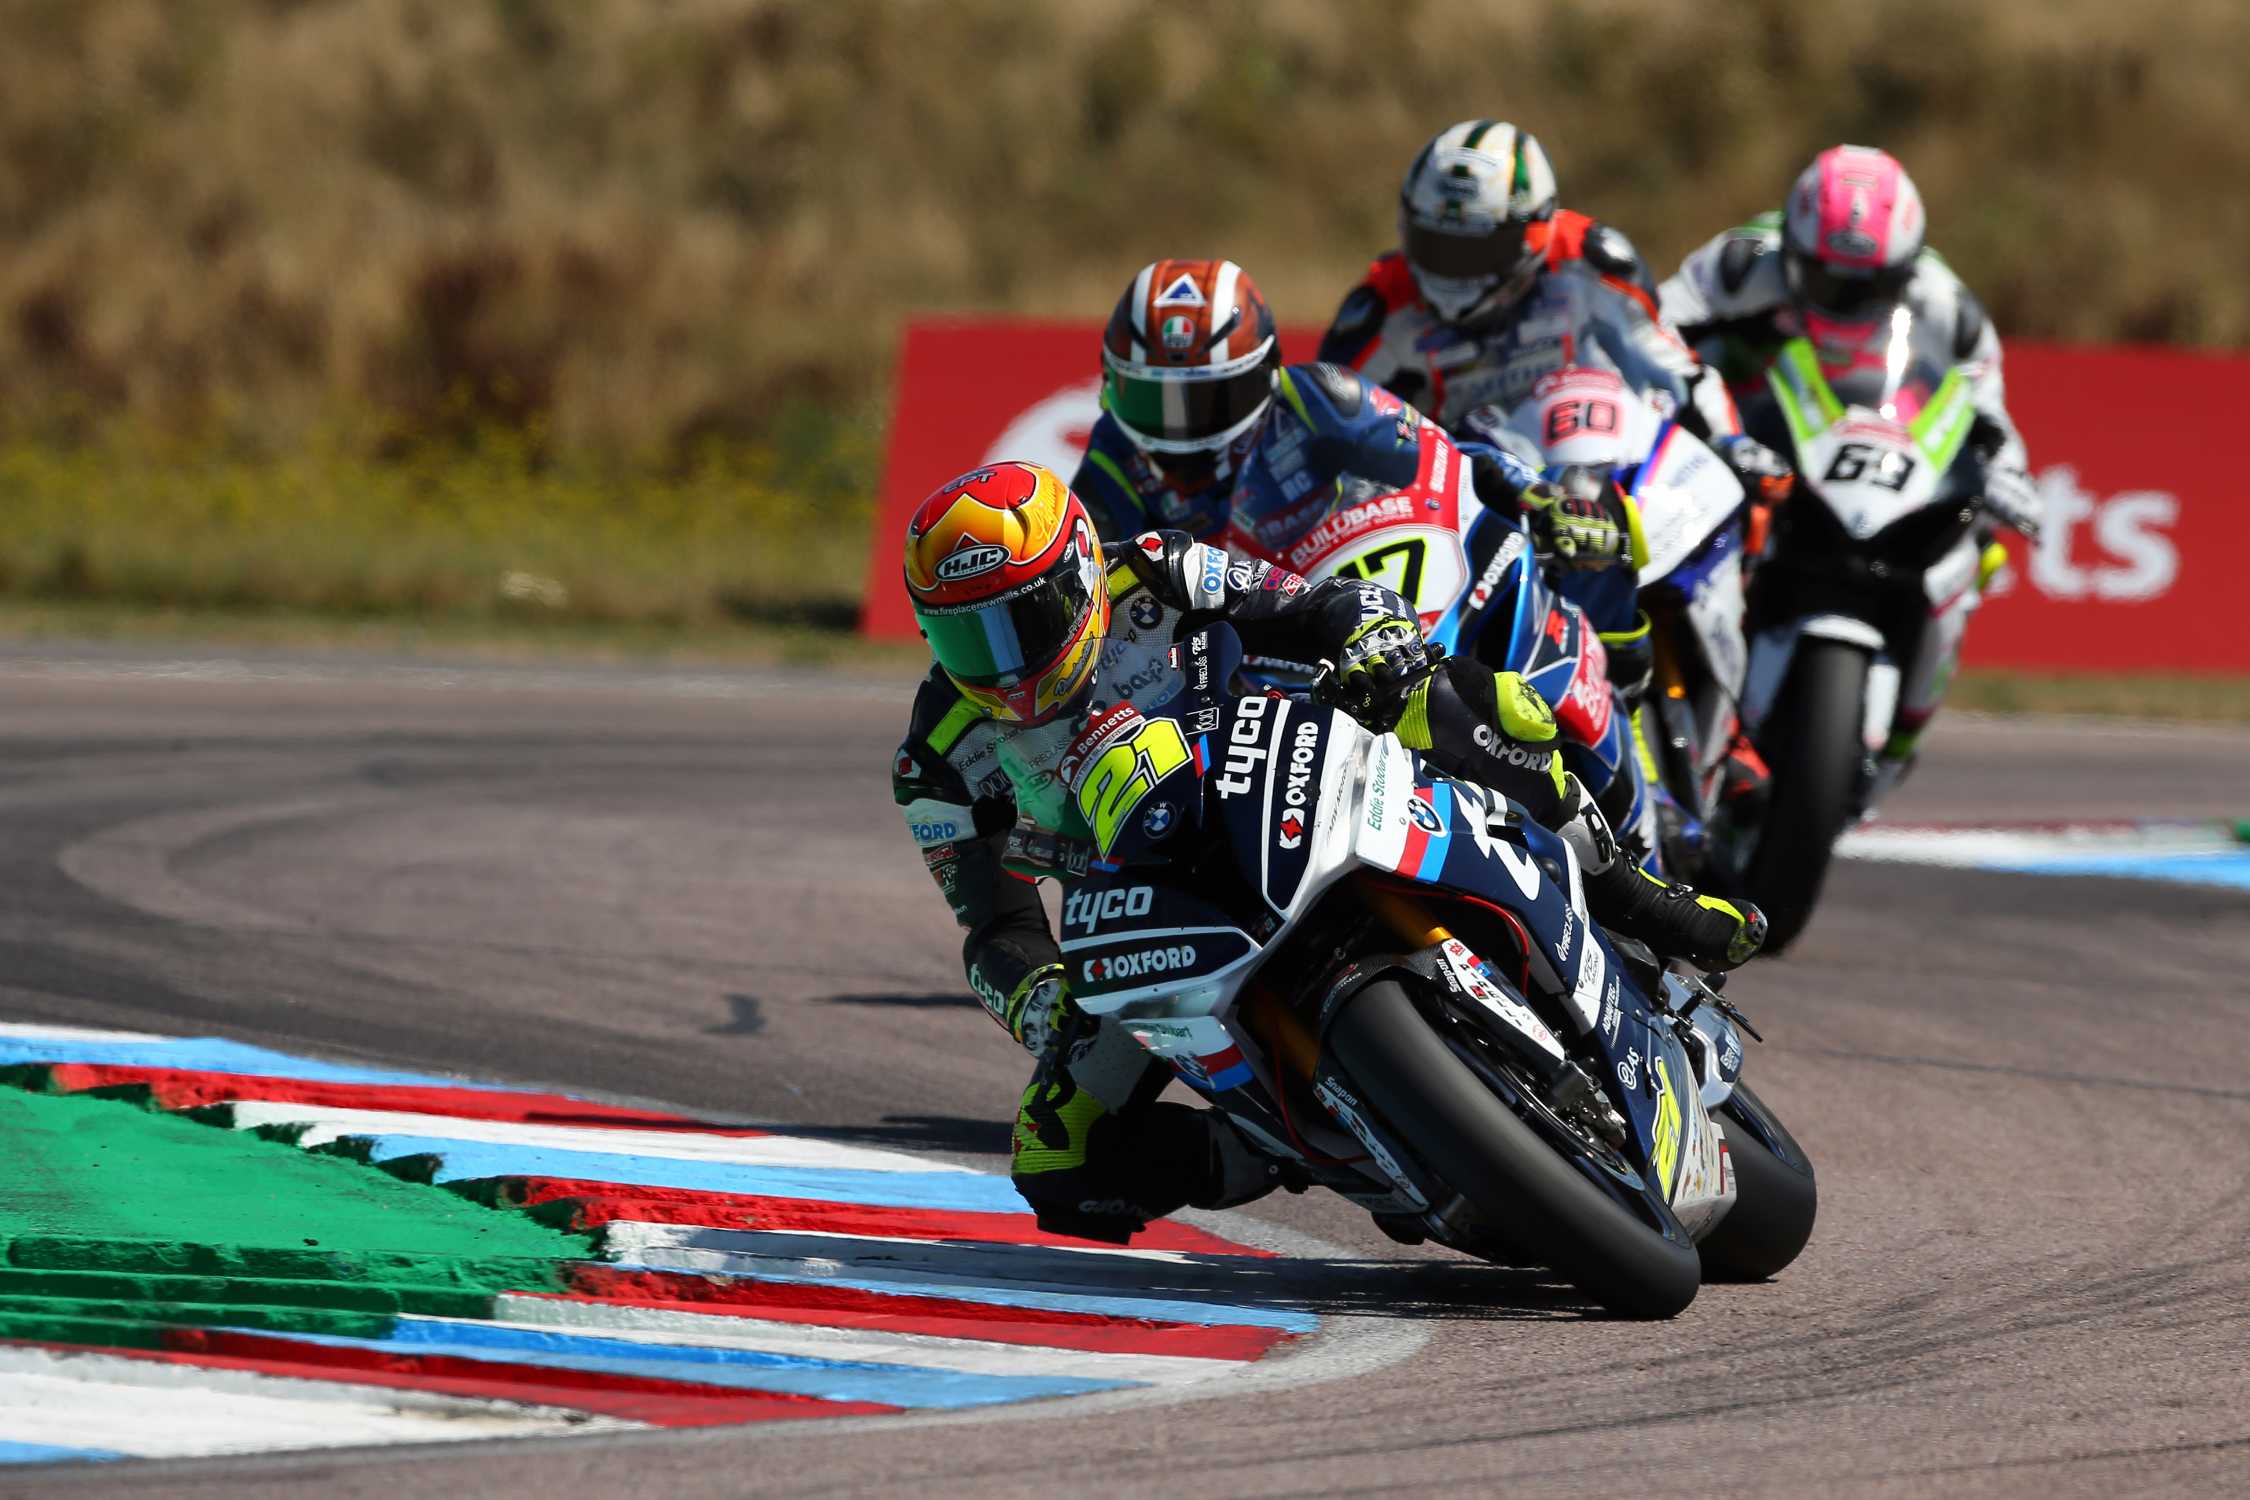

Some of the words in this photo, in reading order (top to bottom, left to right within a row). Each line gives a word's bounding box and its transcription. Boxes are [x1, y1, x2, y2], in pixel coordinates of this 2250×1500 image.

[1549, 399, 1618, 441] 60
[1290, 496, 1413, 567] BUILDBASE
[1988, 463, 2180, 601] ts
[944, 549, 999, 576] HJC
[1077, 706, 1135, 754] Bennetts
[1216, 696, 1268, 799] tyco
[1473, 724, 1552, 772] OXFORD
[1285, 721, 1319, 806] OXFORD
[1078, 717, 1192, 859] 21
[1367, 797, 1385, 831] Eddie
[1064, 886, 1154, 933] tyco
[1115, 945, 1197, 977] OXFORD
